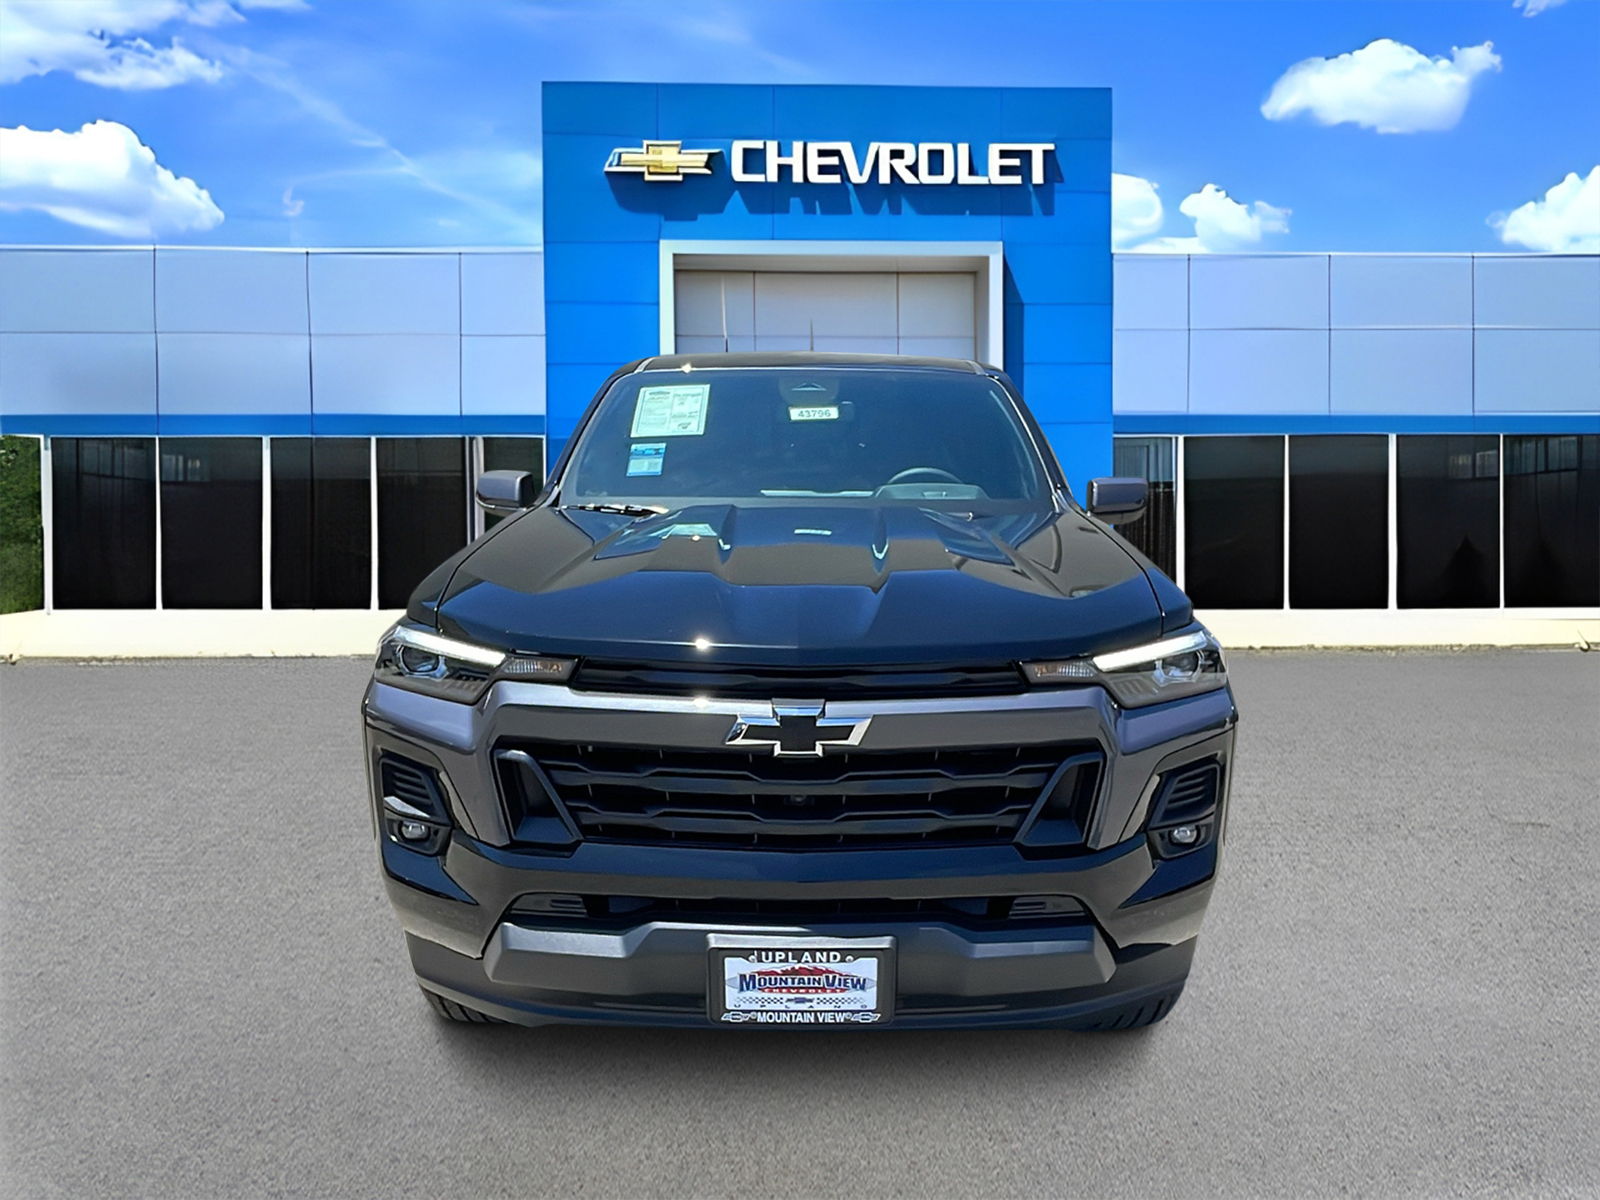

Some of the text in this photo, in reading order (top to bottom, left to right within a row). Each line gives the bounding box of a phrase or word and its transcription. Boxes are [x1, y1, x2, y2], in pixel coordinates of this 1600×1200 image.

[731, 140, 1056, 185] CHEVROLET
[798, 409, 832, 418] 43796
[761, 951, 842, 963] UPLAND
[757, 1012, 815, 1023] MOUNTAIN
[817, 1012, 846, 1023] VIEW
